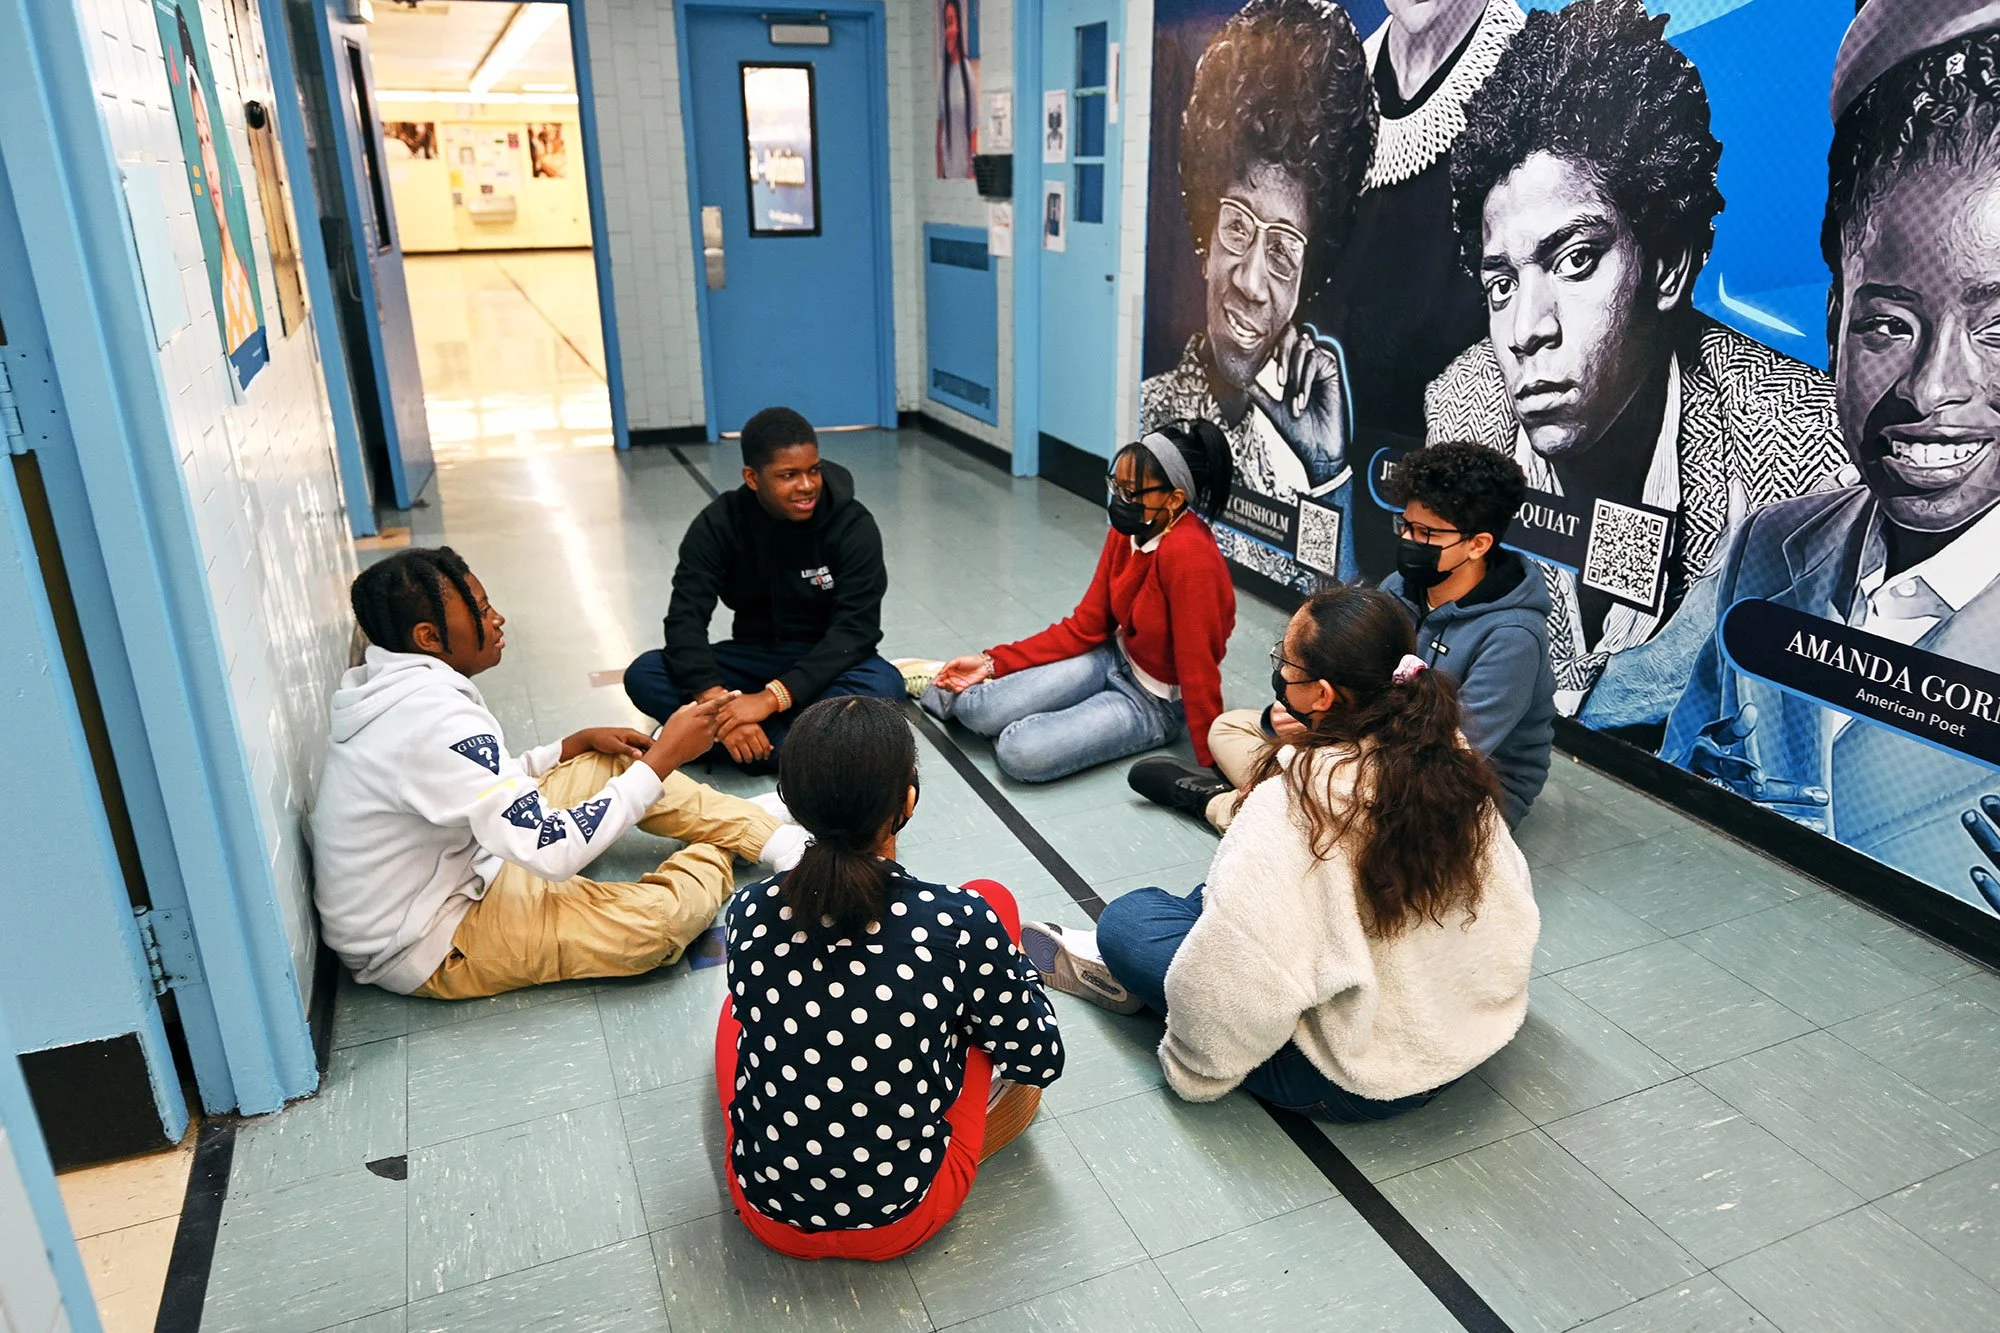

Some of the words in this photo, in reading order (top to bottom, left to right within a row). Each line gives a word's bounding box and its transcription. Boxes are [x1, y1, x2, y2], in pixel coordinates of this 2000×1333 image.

[1785, 630, 1914, 695] AMANDA
[1855, 687, 1926, 723] American
[1929, 713, 1967, 738] Poet
